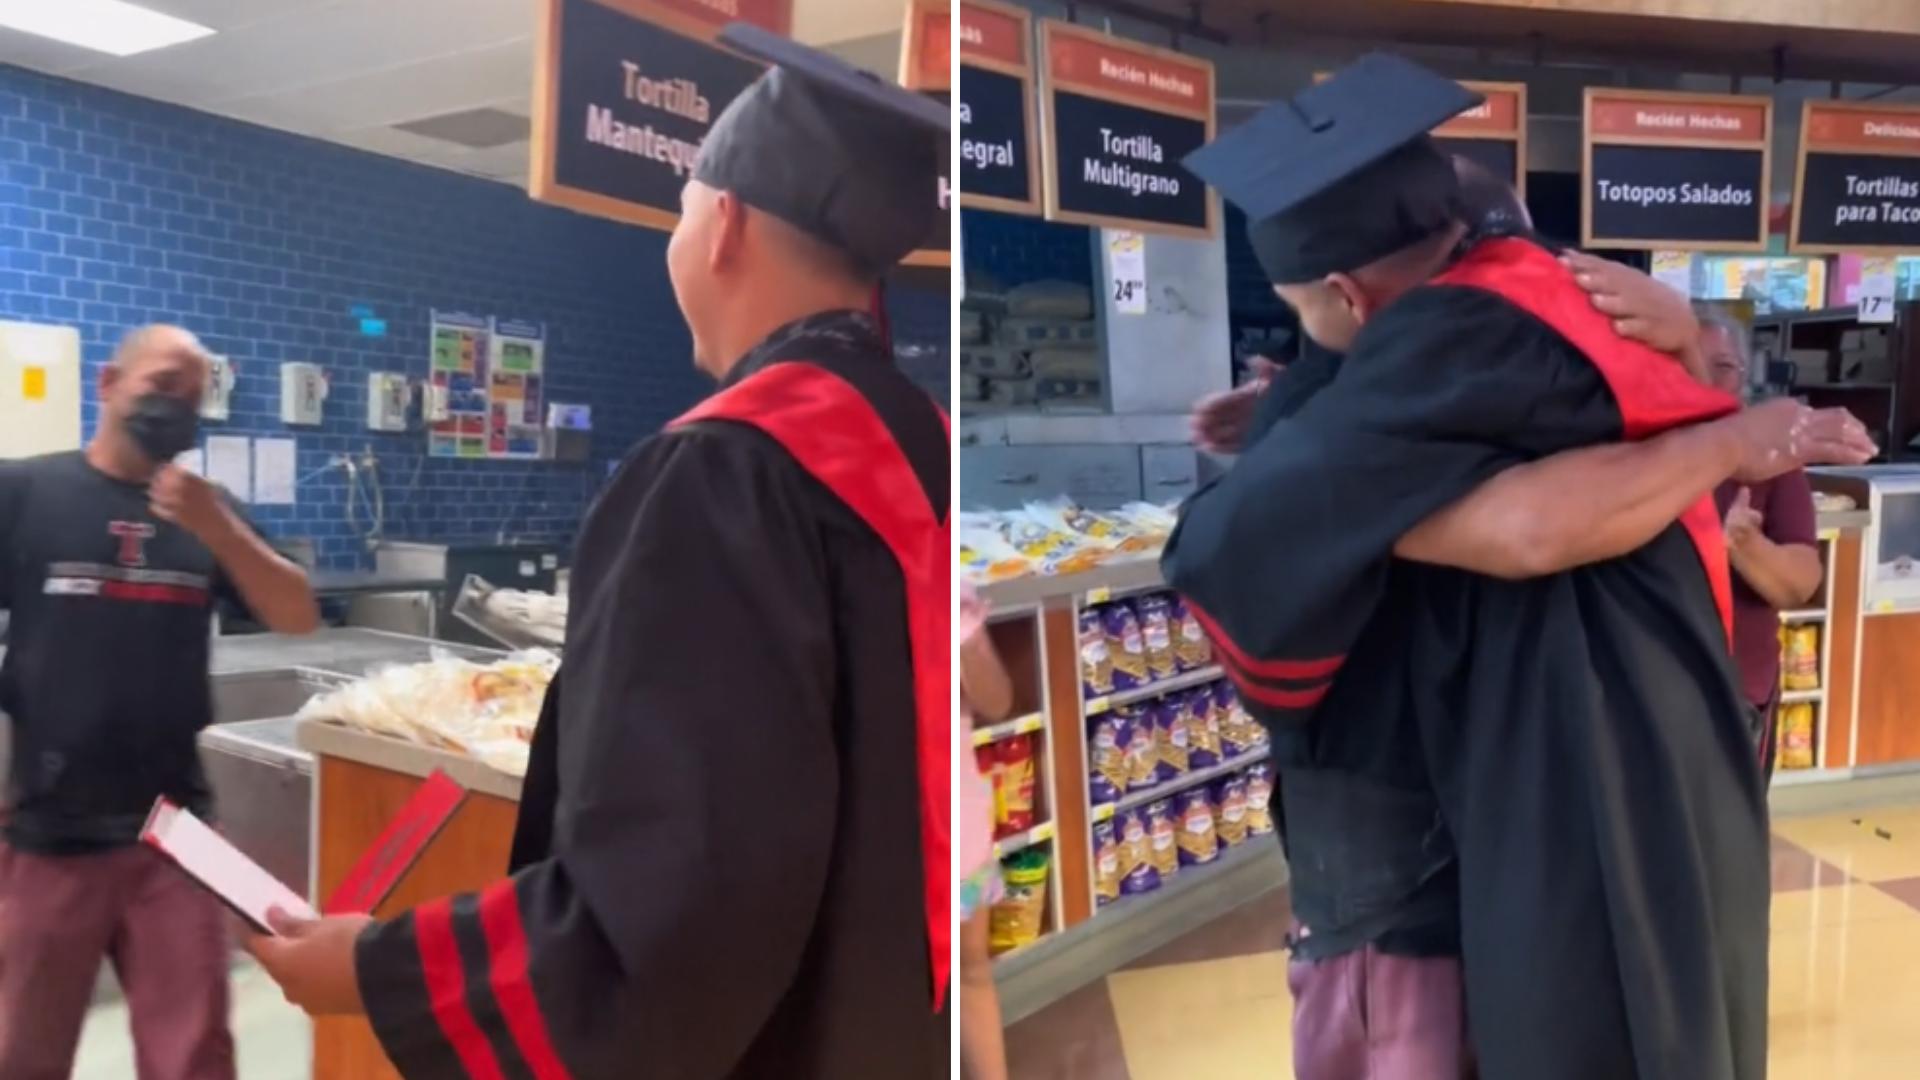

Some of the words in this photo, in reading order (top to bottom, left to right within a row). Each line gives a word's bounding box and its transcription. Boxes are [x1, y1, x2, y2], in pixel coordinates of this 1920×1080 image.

[621, 59, 709, 124] Tortilla
[1100, 127, 1163, 163] Tortilla
[1084, 157, 1179, 196] Multigrano
[1846, 175, 1918, 198] Tortillas
[1598, 179, 1676, 207] Totopos
[1680, 182, 1752, 205] Salados
[1835, 205, 1877, 226] para
[1881, 201, 1920, 222] Taco
